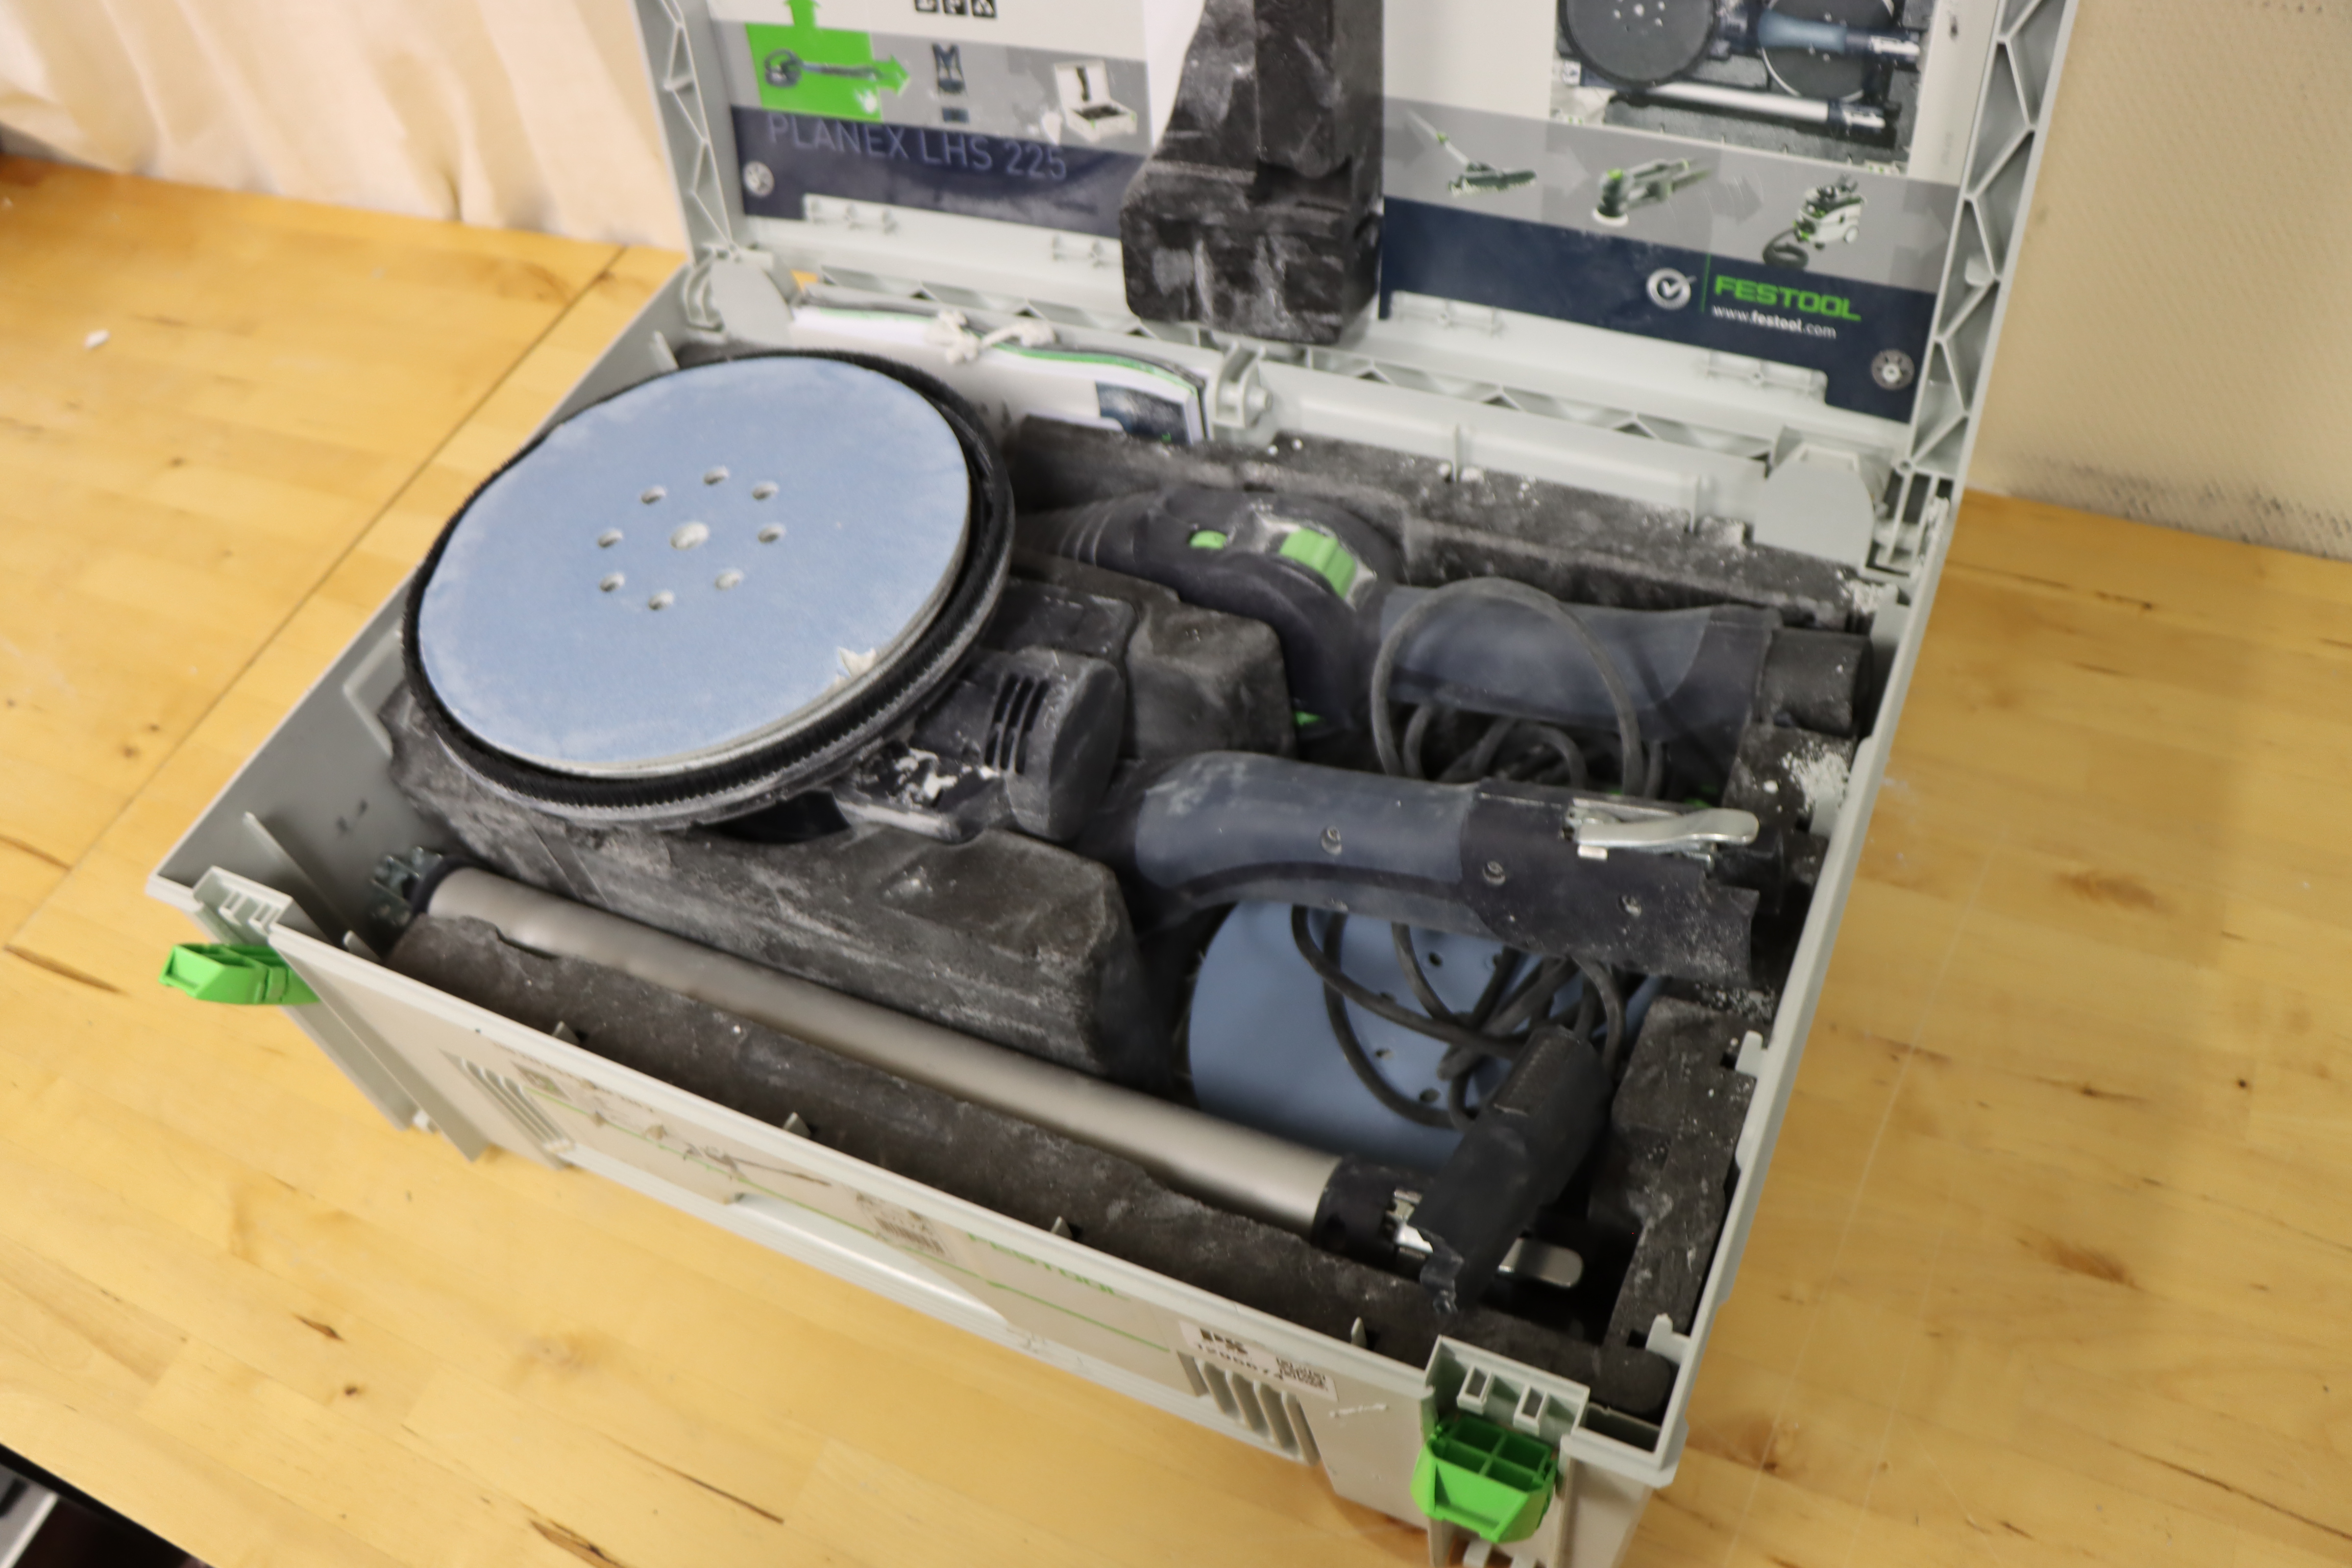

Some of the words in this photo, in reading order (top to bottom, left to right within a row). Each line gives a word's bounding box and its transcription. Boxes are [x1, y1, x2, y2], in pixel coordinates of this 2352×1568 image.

[768, 111, 909, 160] PLANEX
[918, 127, 993, 171] LHS
[1004, 140, 1067, 181] 225
[1711, 304, 1837, 339] www.festool.com
[1715, 274, 1862, 322] FESTOOL
